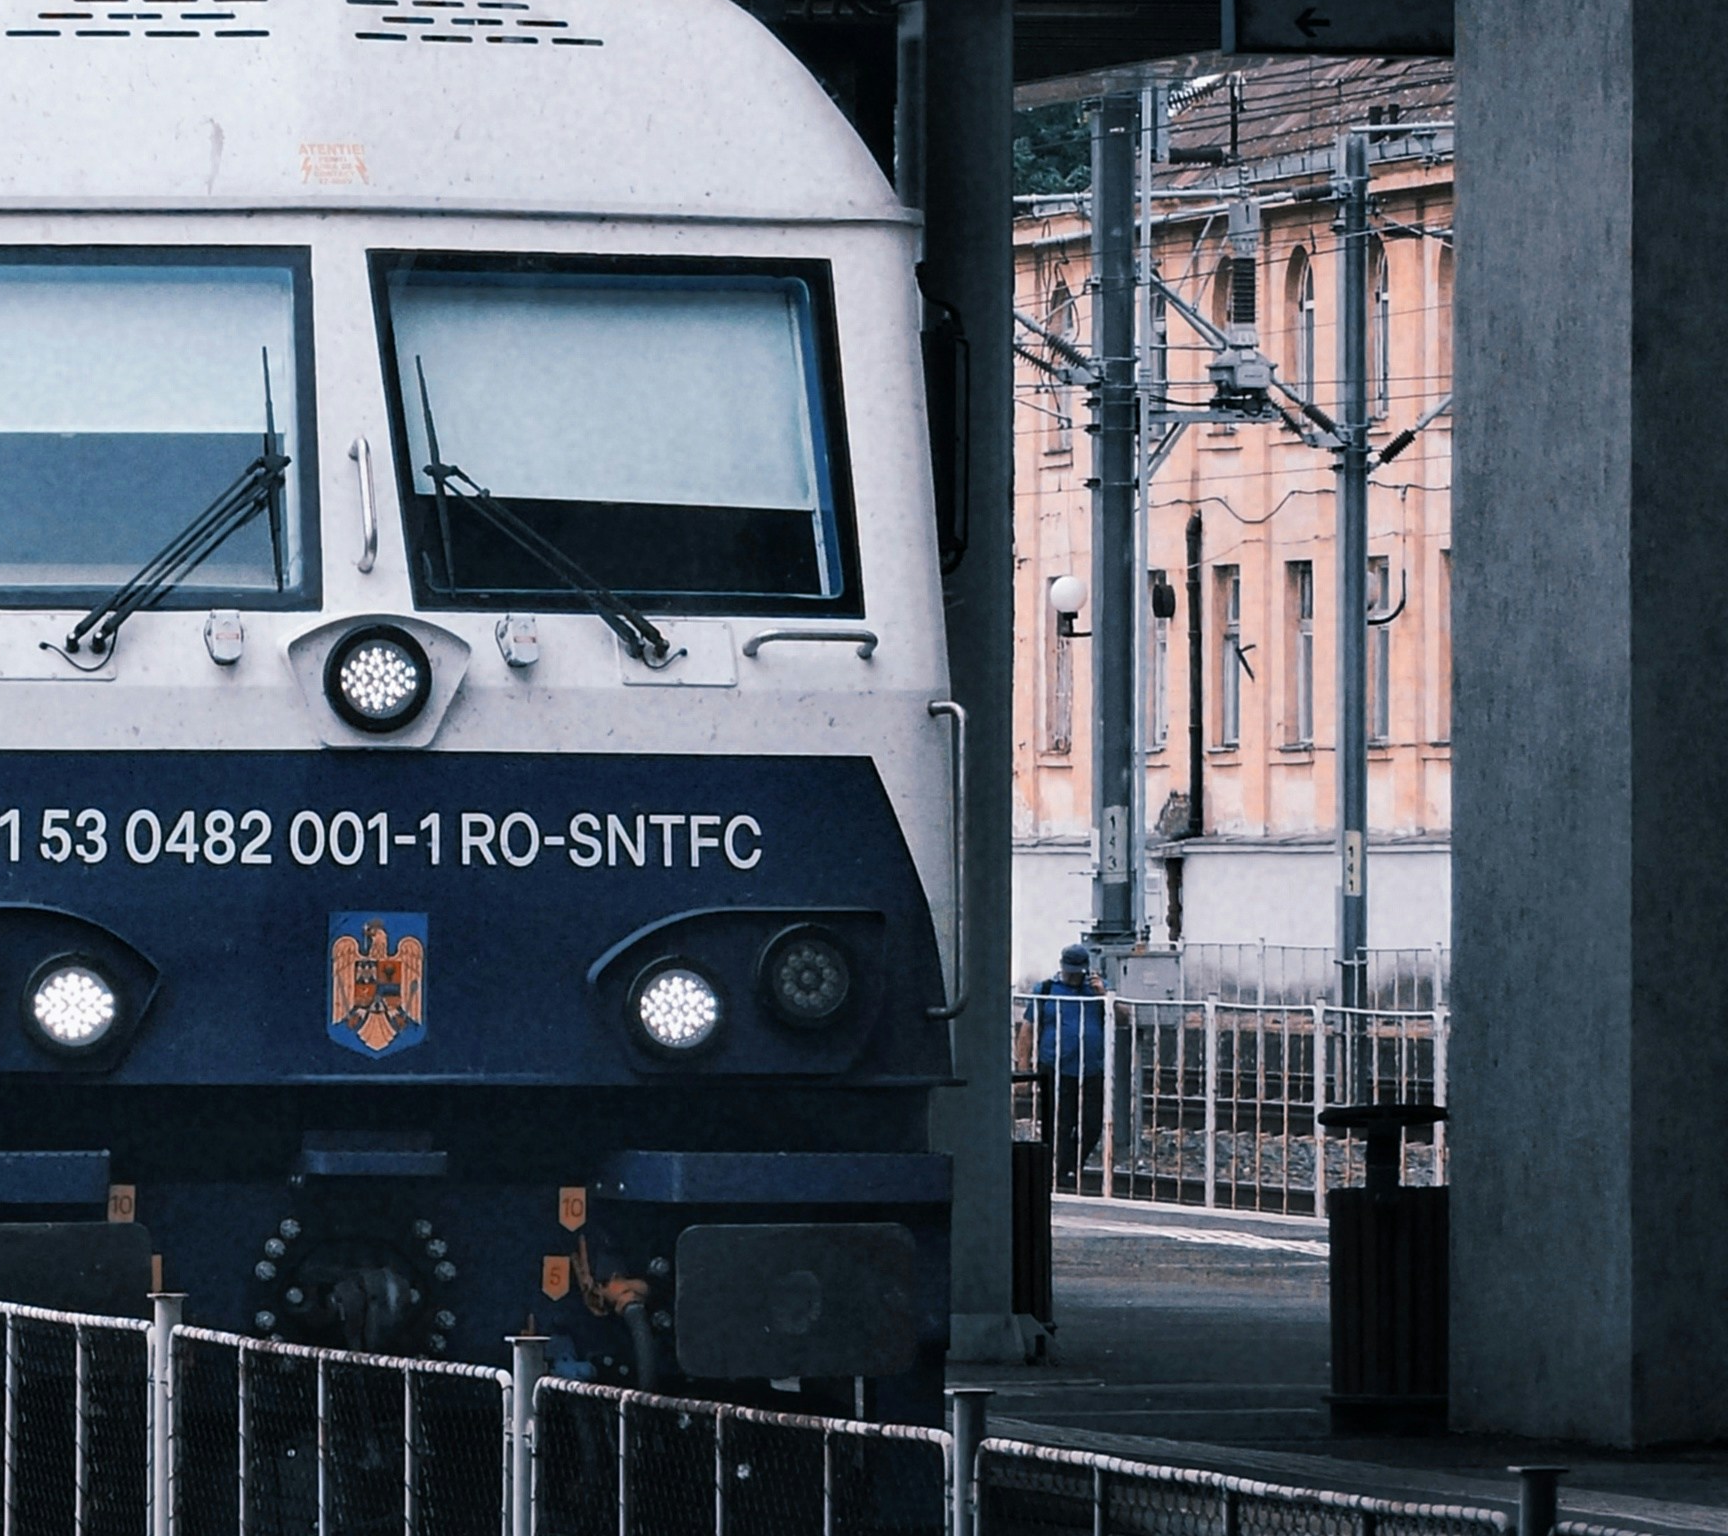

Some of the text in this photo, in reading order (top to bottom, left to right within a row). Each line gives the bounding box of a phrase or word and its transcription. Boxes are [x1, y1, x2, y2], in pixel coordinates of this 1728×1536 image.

[40, 808, 108, 863] 53
[125, 809, 272, 865] 0482
[289, 810, 440, 866] 001-1
[460, 812, 763, 870] RO-SNTFC
[111, 1194, 133, 1215] 10
[561, 1197, 584, 1218] 10
[549, 1266, 561, 1286] 5
